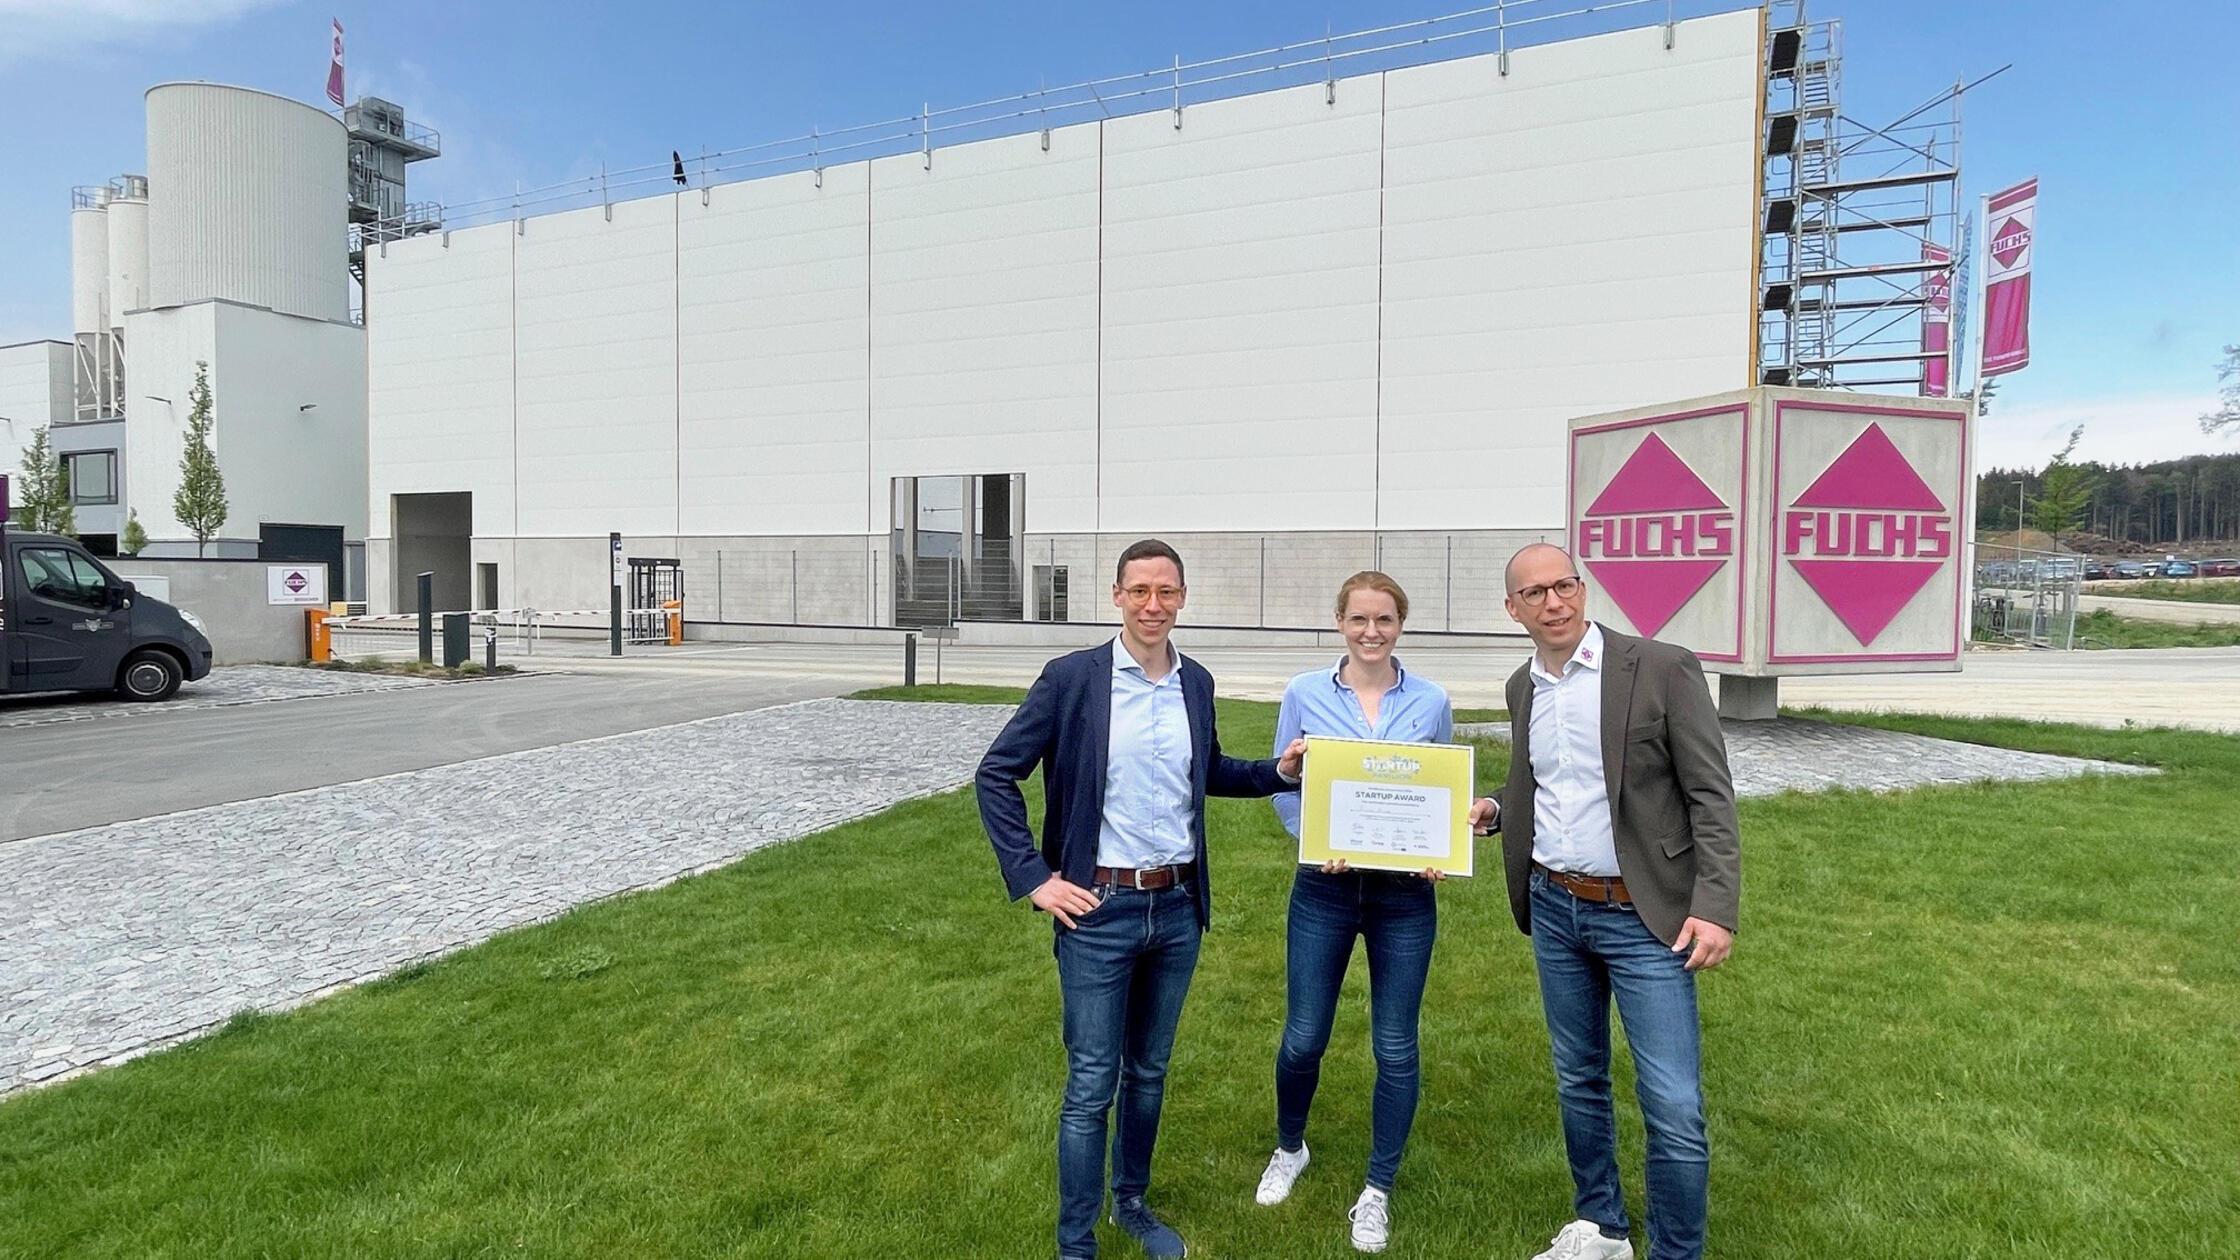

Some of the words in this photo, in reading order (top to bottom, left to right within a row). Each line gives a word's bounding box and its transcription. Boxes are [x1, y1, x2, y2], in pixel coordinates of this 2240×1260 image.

[1990, 231, 2031, 254] FUCHS
[1578, 512, 1734, 559] FUCHS
[1784, 511, 1951, 558] FUCHS
[1355, 791, 1393, 800] STARTUP
[1394, 793, 1426, 802] AWARD
